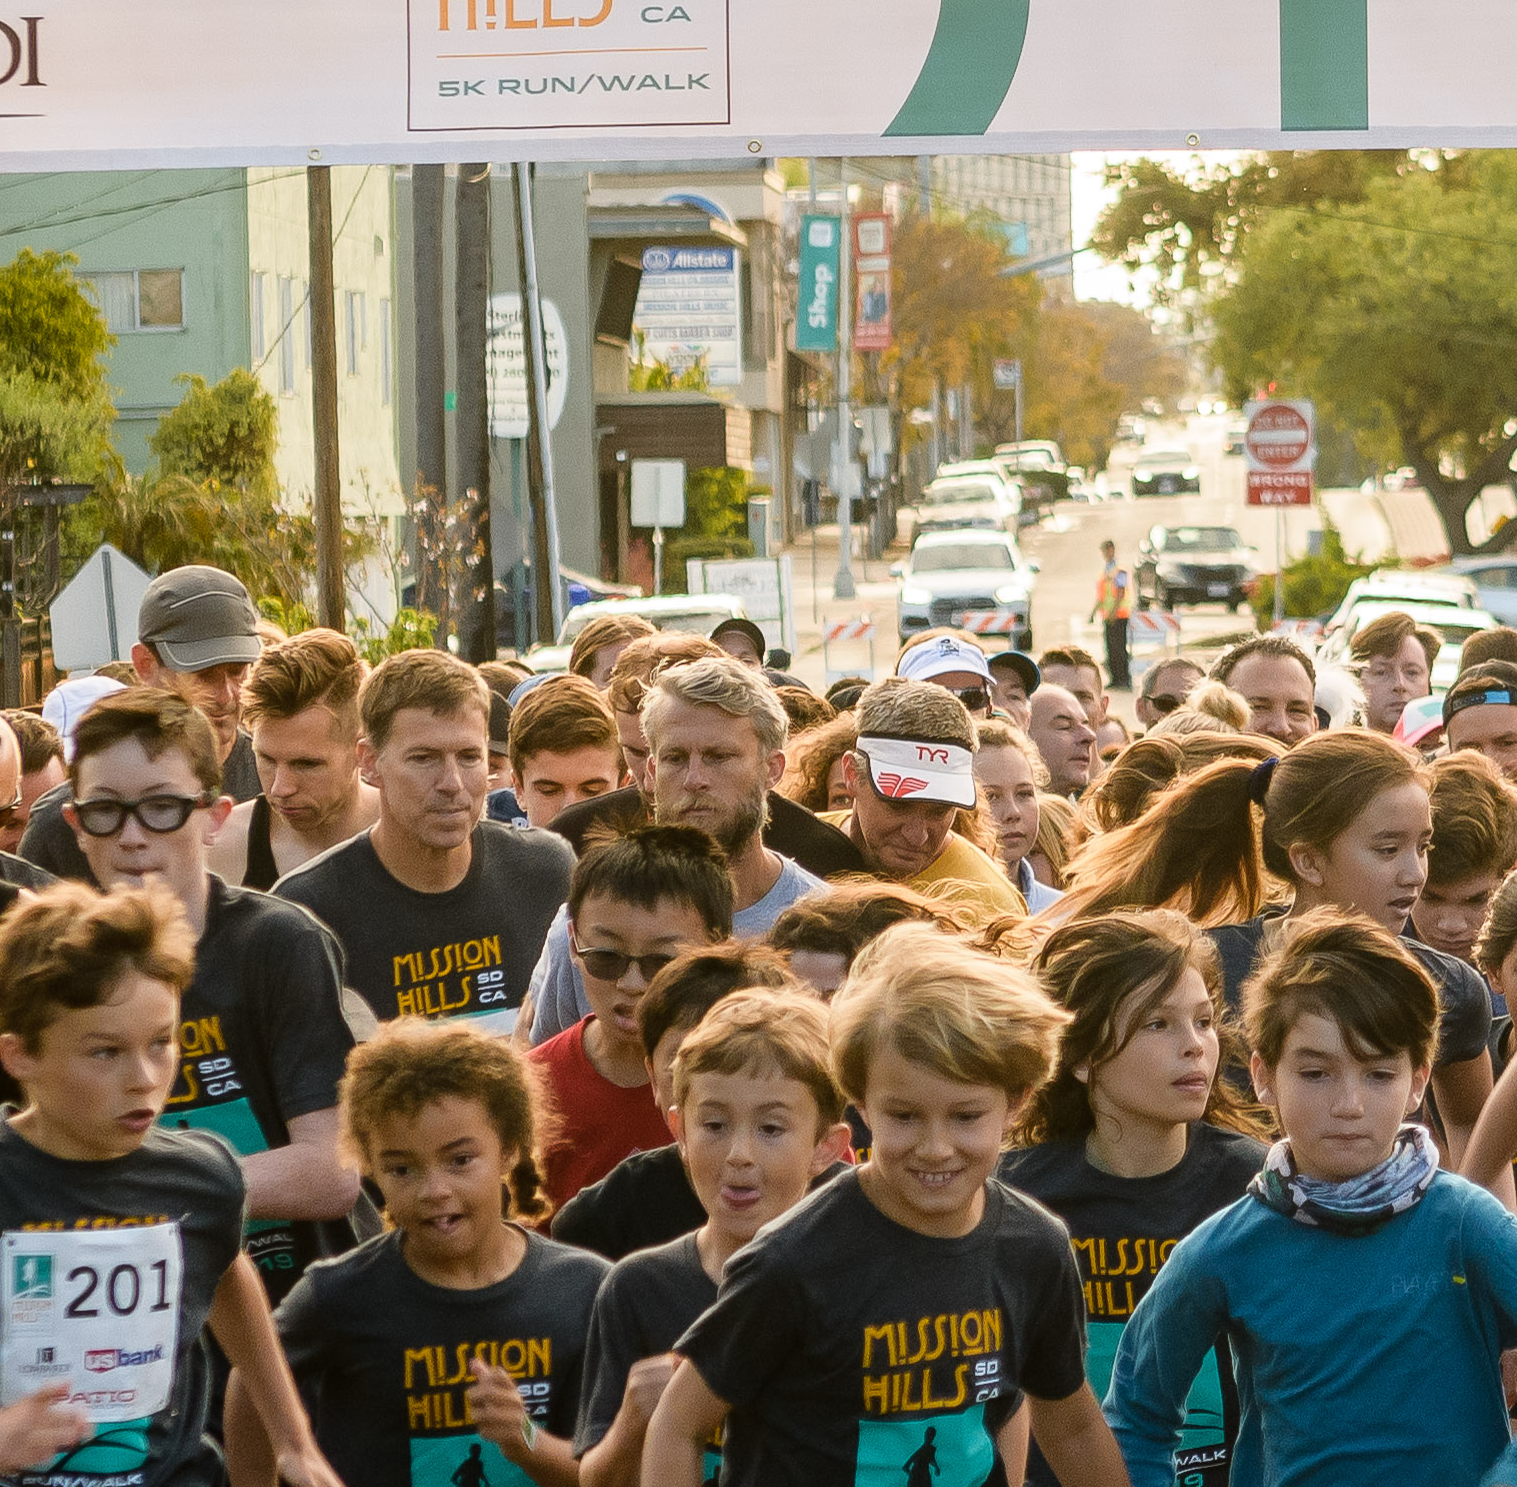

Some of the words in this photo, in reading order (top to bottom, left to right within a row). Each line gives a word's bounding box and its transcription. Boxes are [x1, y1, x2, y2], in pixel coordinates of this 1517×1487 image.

[640, 6, 692, 24] CA
[438, 79, 486, 97] 5K
[498, 73, 711, 96] RUN/WALK
[672, 251, 728, 269] Allstate
[1259, 490, 1297, 503] WAY
[916, 746, 949, 764] TYR
[393, 934, 502, 987] MISSION
[477, 970, 504, 984] SD
[397, 976, 471, 1015] HILLS
[479, 990, 508, 1003] CA
[198, 1057, 232, 1074] SD
[206, 1080, 243, 1097] CA
[64, 1260, 172, 1319] 201
[862, 1307, 1004, 1368] MISSION
[974, 1359, 999, 1376] SD
[517, 1382, 551, 1397] SD
[863, 1363, 970, 1414] HILLS
[407, 1388, 477, 1430] HILL
